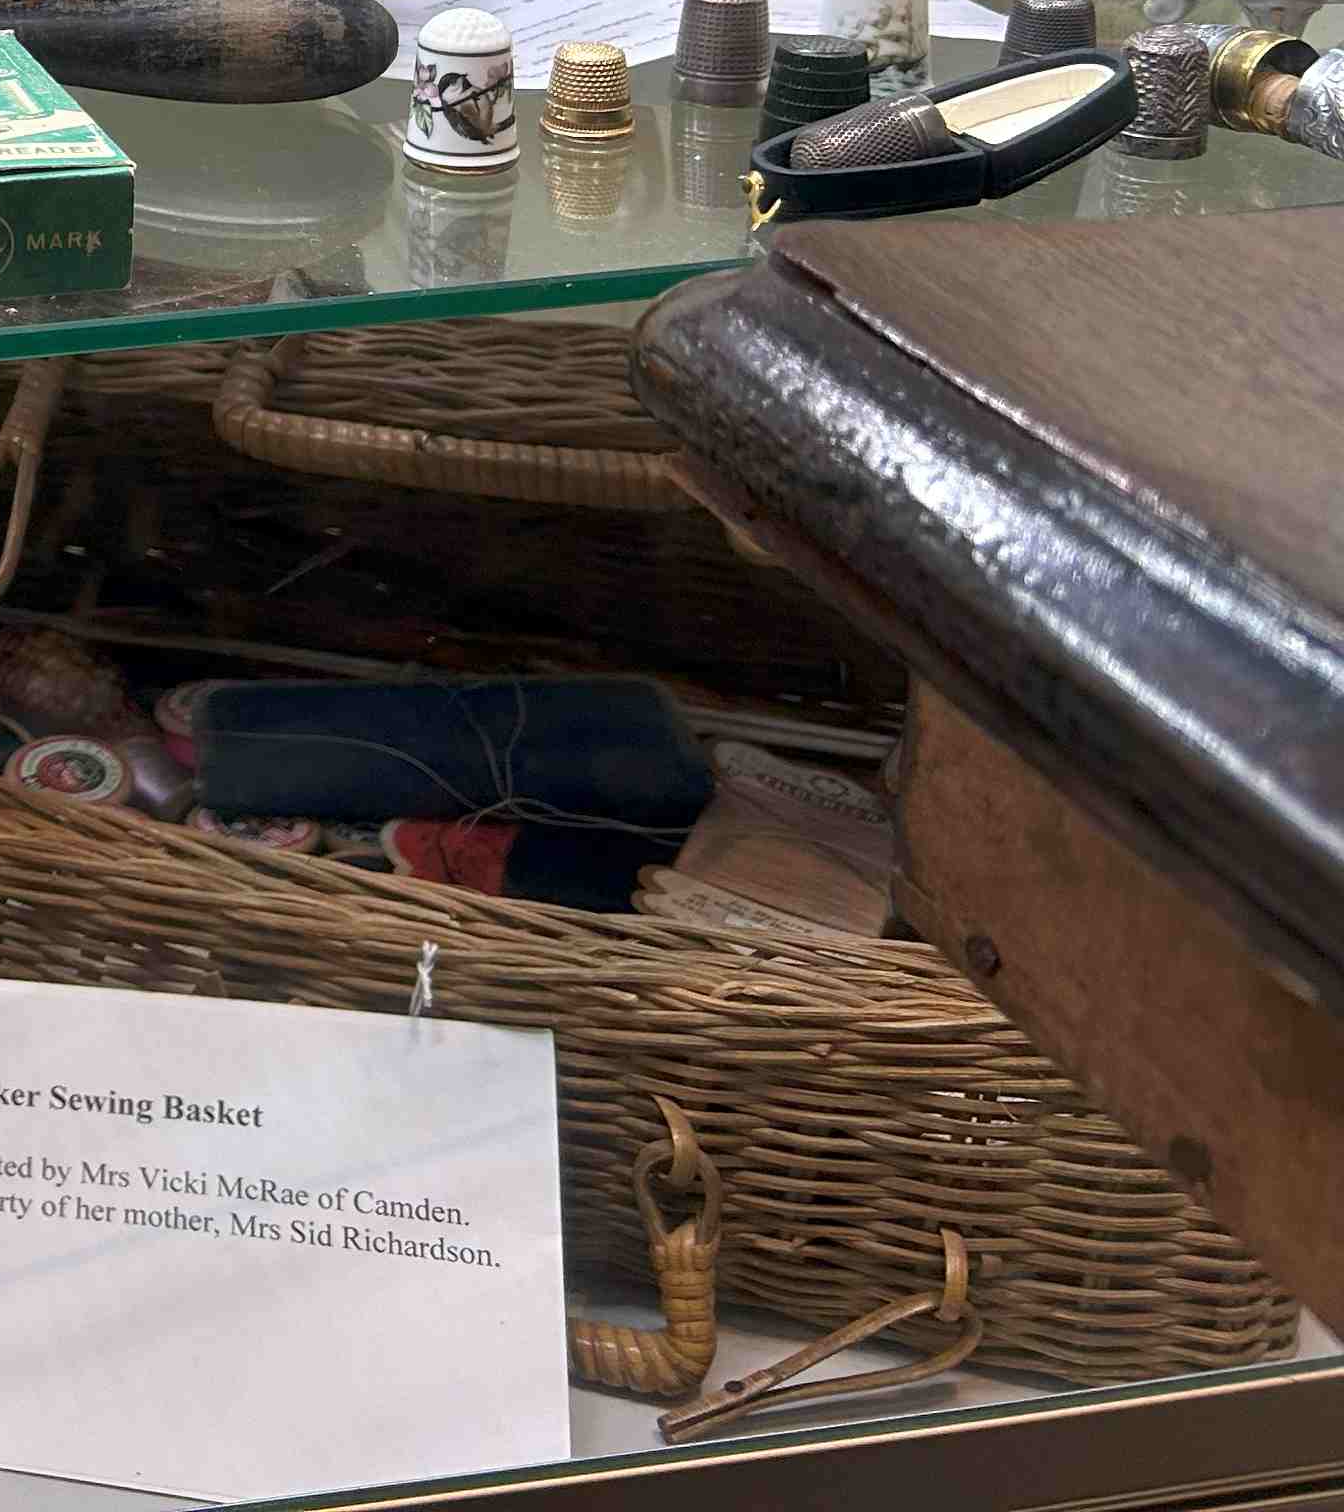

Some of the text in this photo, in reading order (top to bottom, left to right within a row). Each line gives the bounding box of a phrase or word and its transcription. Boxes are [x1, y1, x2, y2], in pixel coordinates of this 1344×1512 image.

[26, 230, 104, 254] MARK
[49, 1085, 153, 1124] Sewing
[163, 1096, 264, 1128] Basket
[41, 1157, 71, 1186] by
[80, 1161, 131, 1189] Mrs
[140, 1167, 208, 1196] Vicki
[217, 1174, 309, 1208] McRae
[318, 1186, 350, 1213] of
[353, 1190, 471, 1227] Camden.
[41, 1194, 73, 1219] of
[76, 1196, 113, 1223] her
[123, 1204, 221, 1239] mother,
[230, 1212, 281, 1241] Mrs
[290, 1220, 333, 1248] Sid
[342, 1228, 502, 1269] Richardson.
